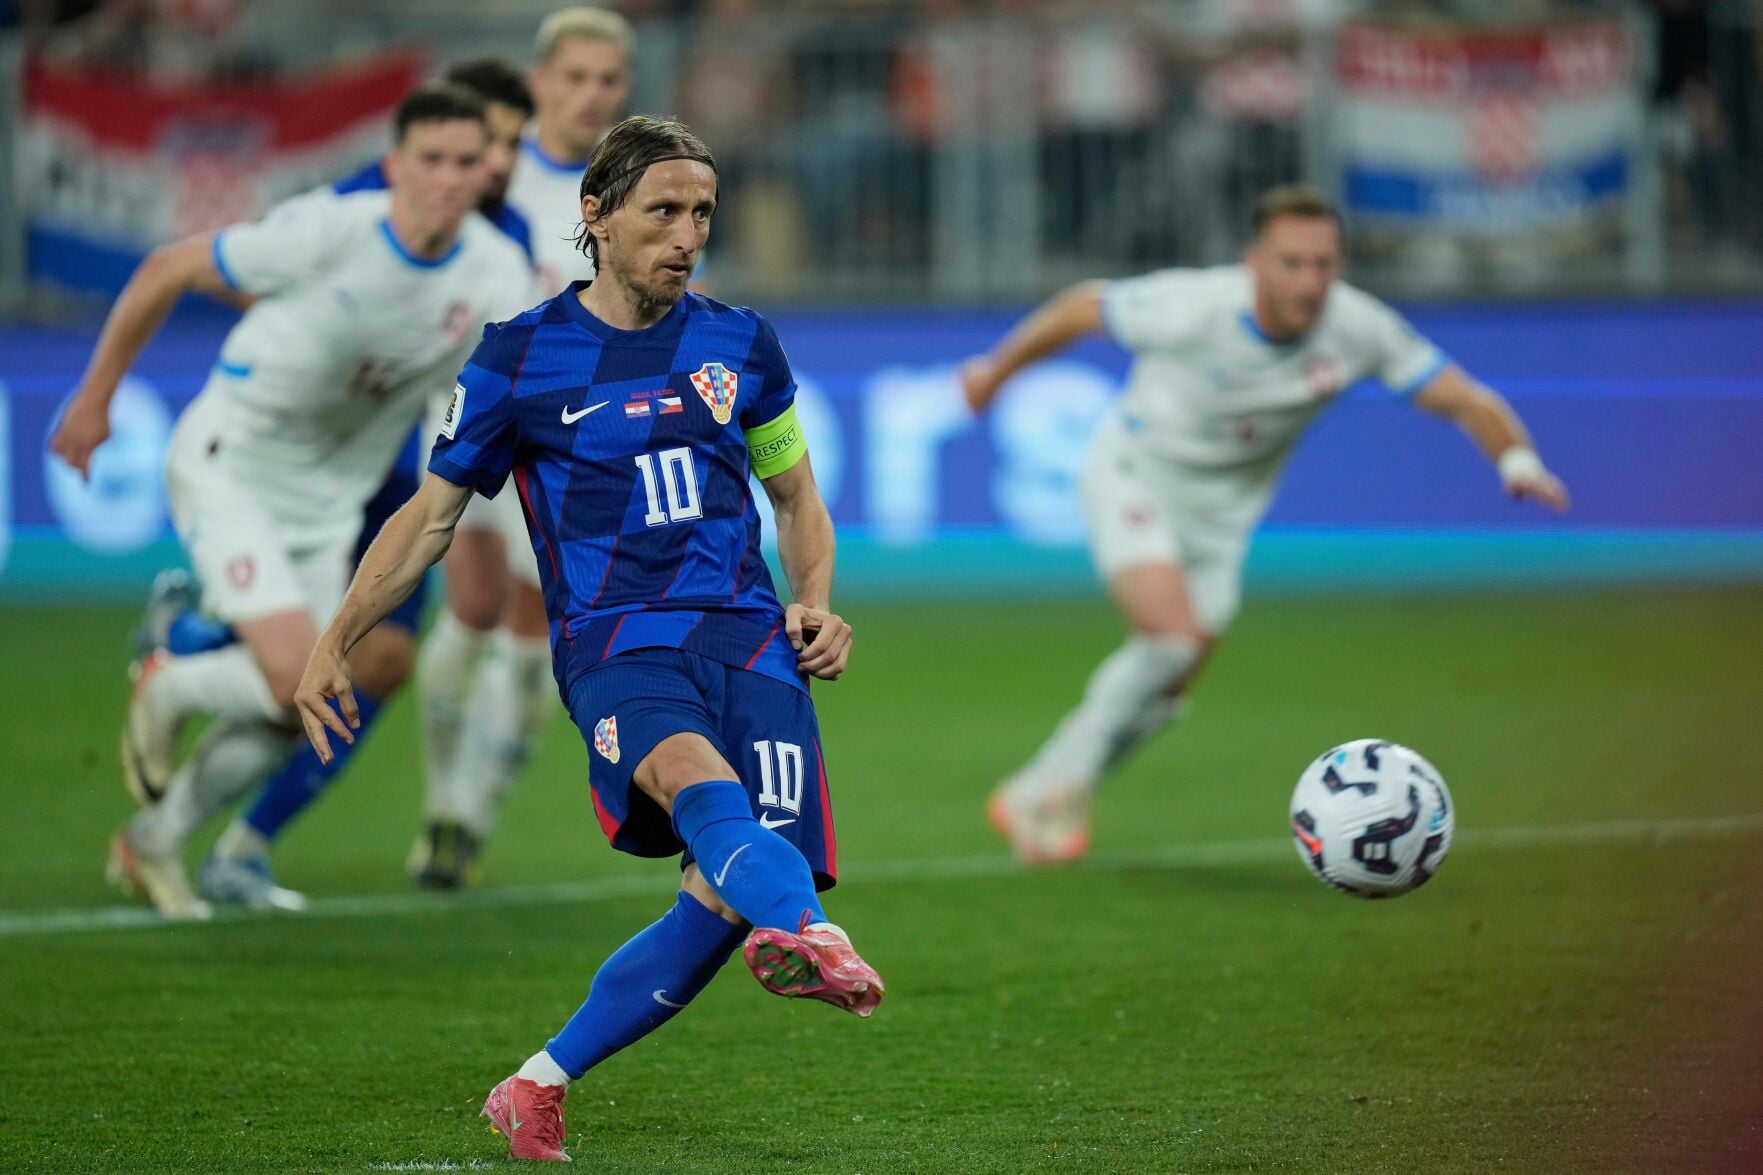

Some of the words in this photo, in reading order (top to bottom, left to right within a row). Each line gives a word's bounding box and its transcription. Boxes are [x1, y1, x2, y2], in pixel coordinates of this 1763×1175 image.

[755, 426, 796, 459] RESPECT
[634, 446, 703, 527] 10
[753, 740, 804, 816] 10
